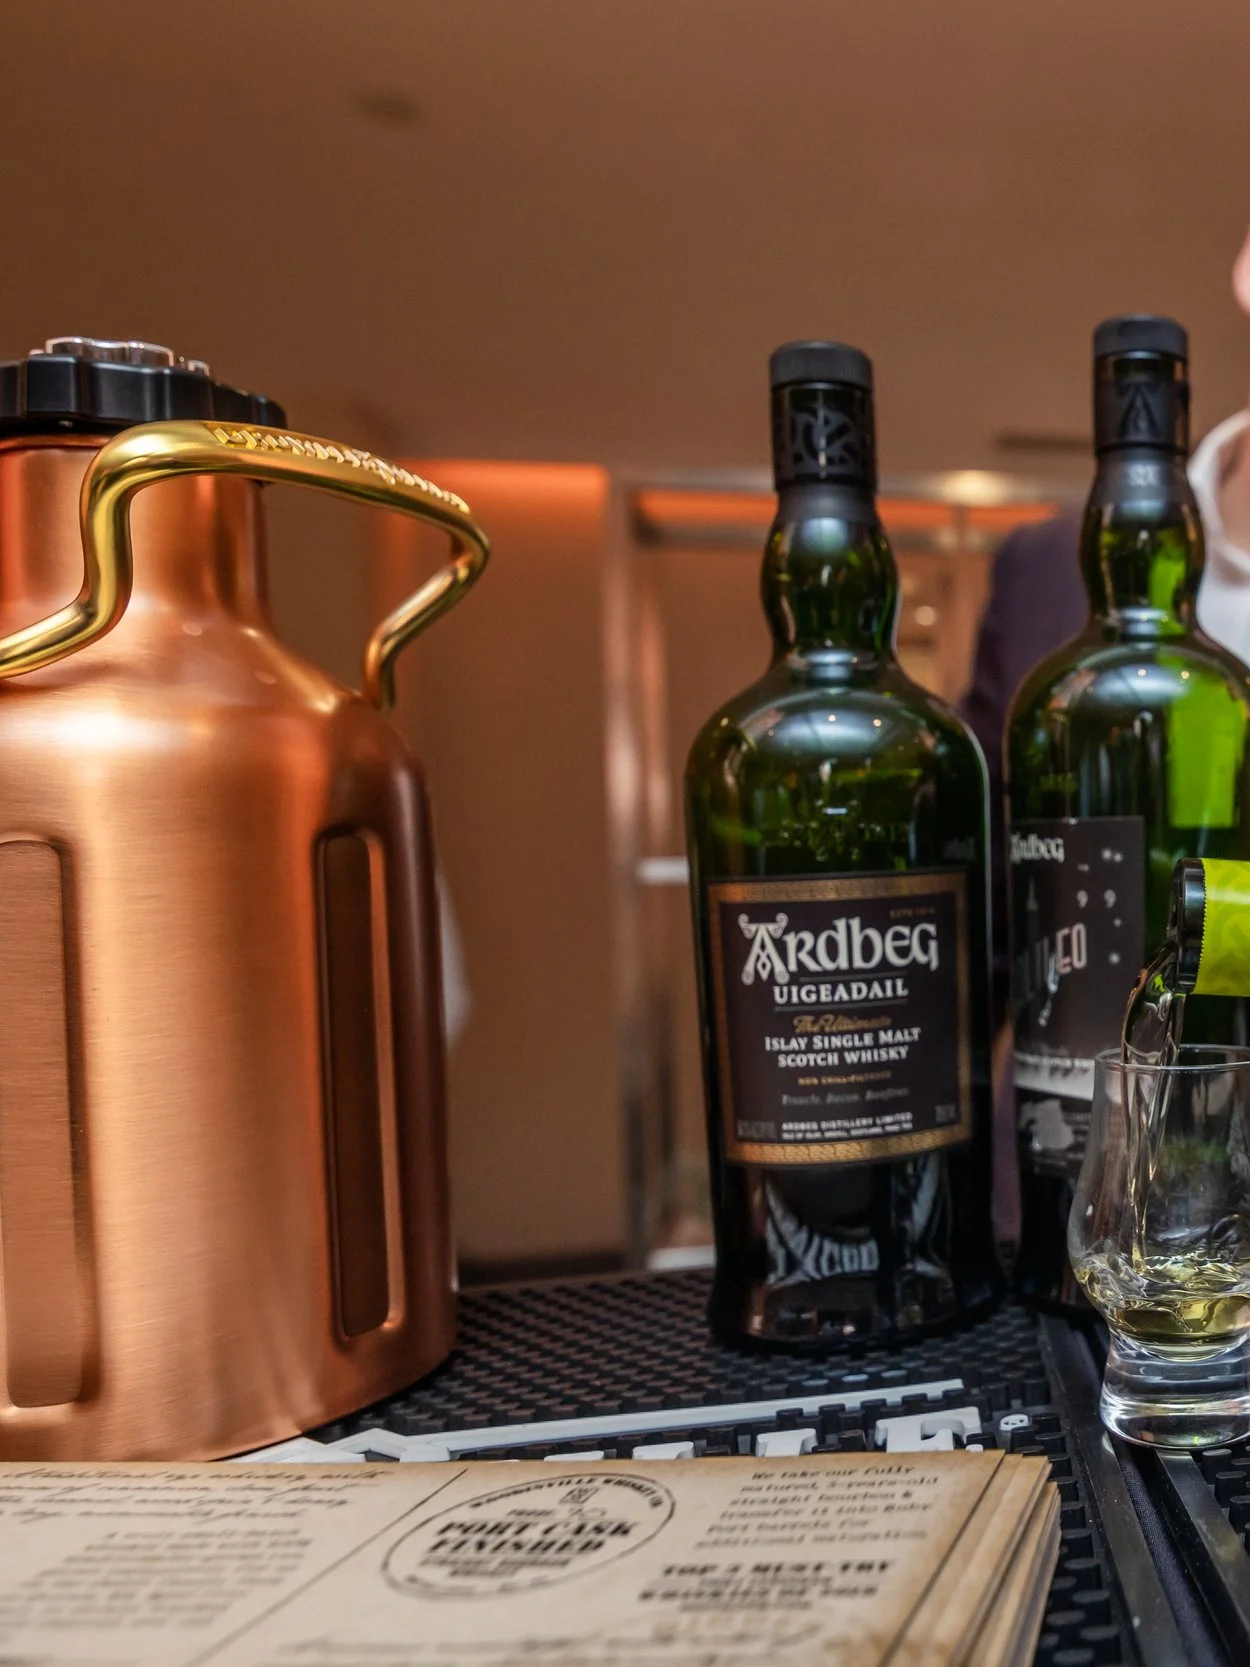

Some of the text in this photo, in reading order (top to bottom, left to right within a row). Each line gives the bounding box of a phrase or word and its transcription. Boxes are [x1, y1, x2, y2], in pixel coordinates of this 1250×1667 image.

[738, 912, 939, 986] Ardbeg
[773, 978, 908, 1004] UIGEADAIL
[765, 1027, 921, 1052] ISLAY SINGLE MALT
[778, 1046, 909, 1068] SCOTCH WHISKY
[752, 1471, 774, 1481] We
[780, 1469, 821, 1479] take
[863, 1466, 915, 1477] fully
[436, 1520, 637, 1537] PORT CASK
[427, 1538, 606, 1555] FINISHED
